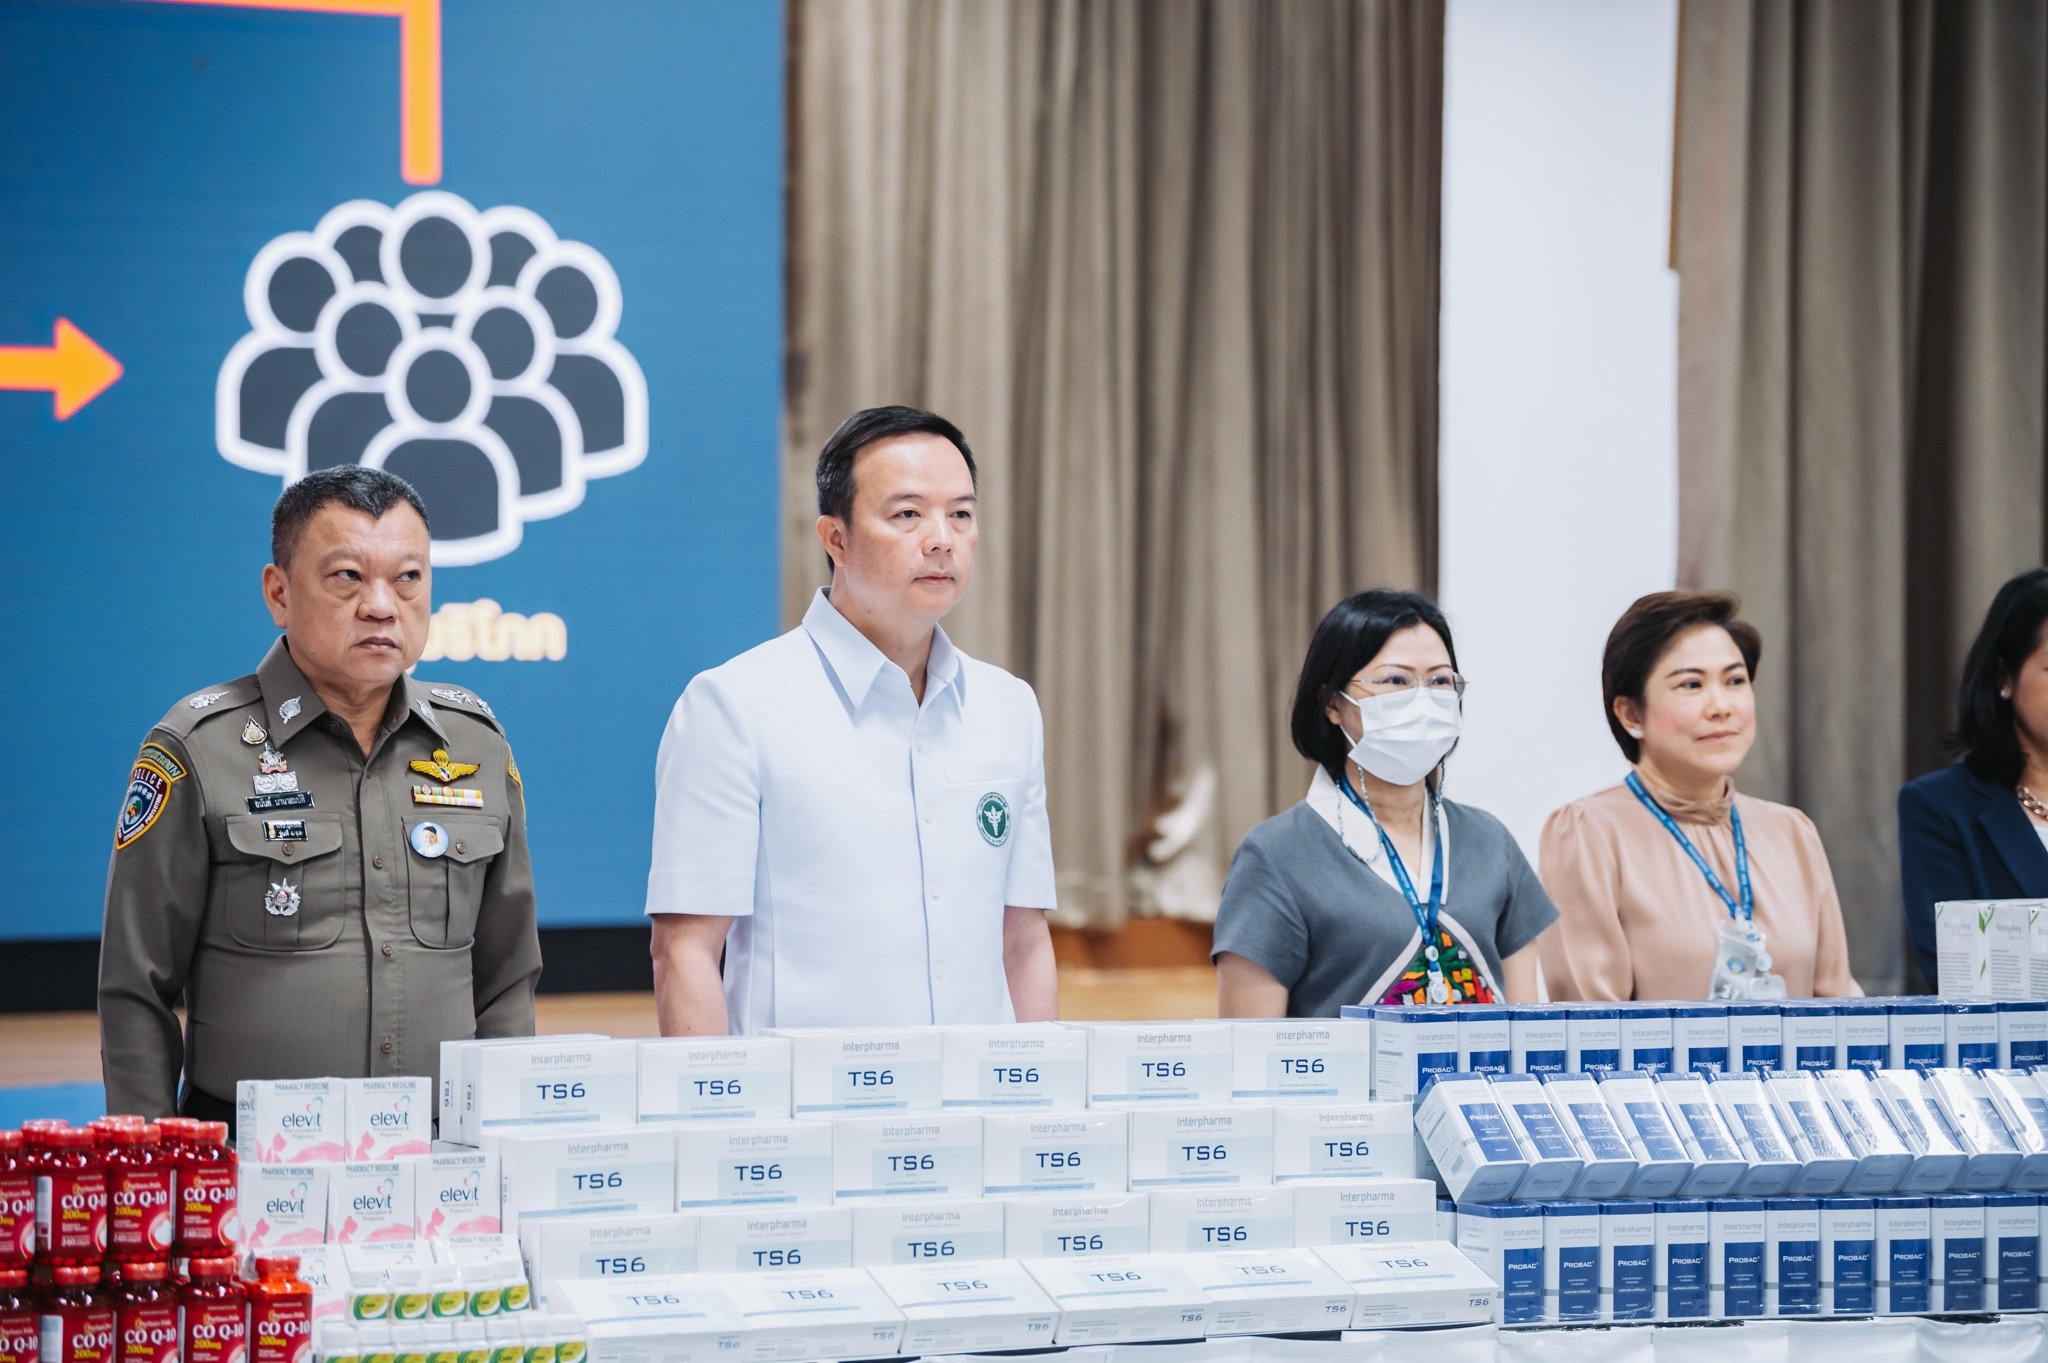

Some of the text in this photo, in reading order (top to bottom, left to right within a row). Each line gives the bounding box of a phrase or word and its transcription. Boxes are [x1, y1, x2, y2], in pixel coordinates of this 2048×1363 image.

[134, 769, 163, 789] POLICE
[1137, 1034, 1191, 1045] Interpharma
[1276, 1031, 1330, 1042] Interpharma
[843, 1042, 900, 1054] Interpharma
[988, 1039, 1044, 1051] Interpharma
[531, 1053, 591, 1065] Interpharma
[688, 1050, 747, 1062] Interpharma
[1141, 1062, 1186, 1078] TS6
[1281, 1058, 1325, 1074] TS6
[848, 1070, 894, 1087] TS6
[994, 1068, 1039, 1084] TS6
[304, 1082, 329, 1090] MEDICINE
[391, 1081, 416, 1089] MEDICINE
[536, 1082, 586, 1100] TS6
[694, 1079, 742, 1097] TS6
[282, 1113, 321, 1127] elevit
[370, 1111, 409, 1126] elevit
[1177, 1117, 1232, 1128] Interpharma
[1319, 1113, 1374, 1125] Interpharma
[883, 1125, 940, 1138] Interpharma
[1030, 1124, 1086, 1135] Interpharma
[729, 1135, 788, 1147] Interpharma
[568, 1143, 629, 1155] Interpharma
[1182, 1145, 1227, 1162] TS6
[1325, 1141, 1369, 1158] TS6
[887, 1154, 934, 1172] TS6
[1036, 1152, 1081, 1168] TS6
[261, 1168, 289, 1176] PHARMACY
[346, 1164, 399, 1173] PHARMACY MEDICINE
[734, 1164, 782, 1181] TS6
[573, 1172, 623, 1190] TS6
[114, 1191, 167, 1208] CO Q-10
[184, 1187, 236, 1204] CO Q-10
[440, 1187, 478, 1202] elevit
[1340, 1192, 1395, 1204] Interpharma
[12, 1199, 35, 1216] Q-10
[61, 1194, 84, 1209] CO
[267, 1198, 304, 1213] elevit
[353, 1196, 391, 1210] elevit
[1196, 1198, 1251, 1210] Interpharma
[115, 1207, 142, 1217] 200mg
[185, 1203, 212, 1213] 200mg
[1052, 1207, 1108, 1218] Interpharma
[62, 1210, 90, 1220] 200mg
[902, 1210, 960, 1223] Interpharma
[747, 1219, 807, 1232] Interpharma
[1723, 1223, 1762, 1232] Interpharma
[1777, 1222, 1816, 1231] Interpharma
[1833, 1221, 1872, 1231] Interpharma
[1889, 1220, 1927, 1230] Interpharma
[1943, 1219, 1982, 1229] Interpharma
[1998, 1217, 2036, 1227] Interpharma
[589, 1227, 651, 1240] Interpharma
[1202, 1226, 1247, 1243] TS6
[1345, 1220, 1390, 1237] TS6
[1503, 1229, 1540, 1238] Interpharma
[1559, 1227, 1597, 1237] Interpharma
[1613, 1226, 1652, 1235] Interpharma
[1667, 1224, 1705, 1233] Interpharma
[908, 1241, 955, 1258] TS6
[1058, 1235, 1103, 1252] TS6
[753, 1249, 801, 1267] TS6
[1380, 1259, 1428, 1268] TS6
[596, 1256, 646, 1274] TS6
[1235, 1265, 1286, 1275] TS6
[302, 1272, 328, 1285] evit
[1090, 1271, 1141, 1283] TS6
[937, 1280, 989, 1291] TS6
[626, 1295, 680, 1305] TS6
[781, 1289, 834, 1300] TS6
[1325, 1305, 1347, 1313] TS6
[193, 1323, 244, 1340] CO Q-10
[258, 1320, 310, 1337] CO Q-10
[1026, 1323, 1050, 1331] TS6
[72, 1334, 95, 1348] CO
[125, 1328, 176, 1345] CO Q-10
[260, 1337, 286, 1346] 200mg
[872, 1332, 895, 1340] TS6
[14, 1337, 38, 1353] Q-10
[126, 1345, 154, 1354] 200mg
[194, 1340, 221, 1349] 200mg
[718, 1341, 741, 1349] TS6
[74, 1349, 100, 1359] 200mg
